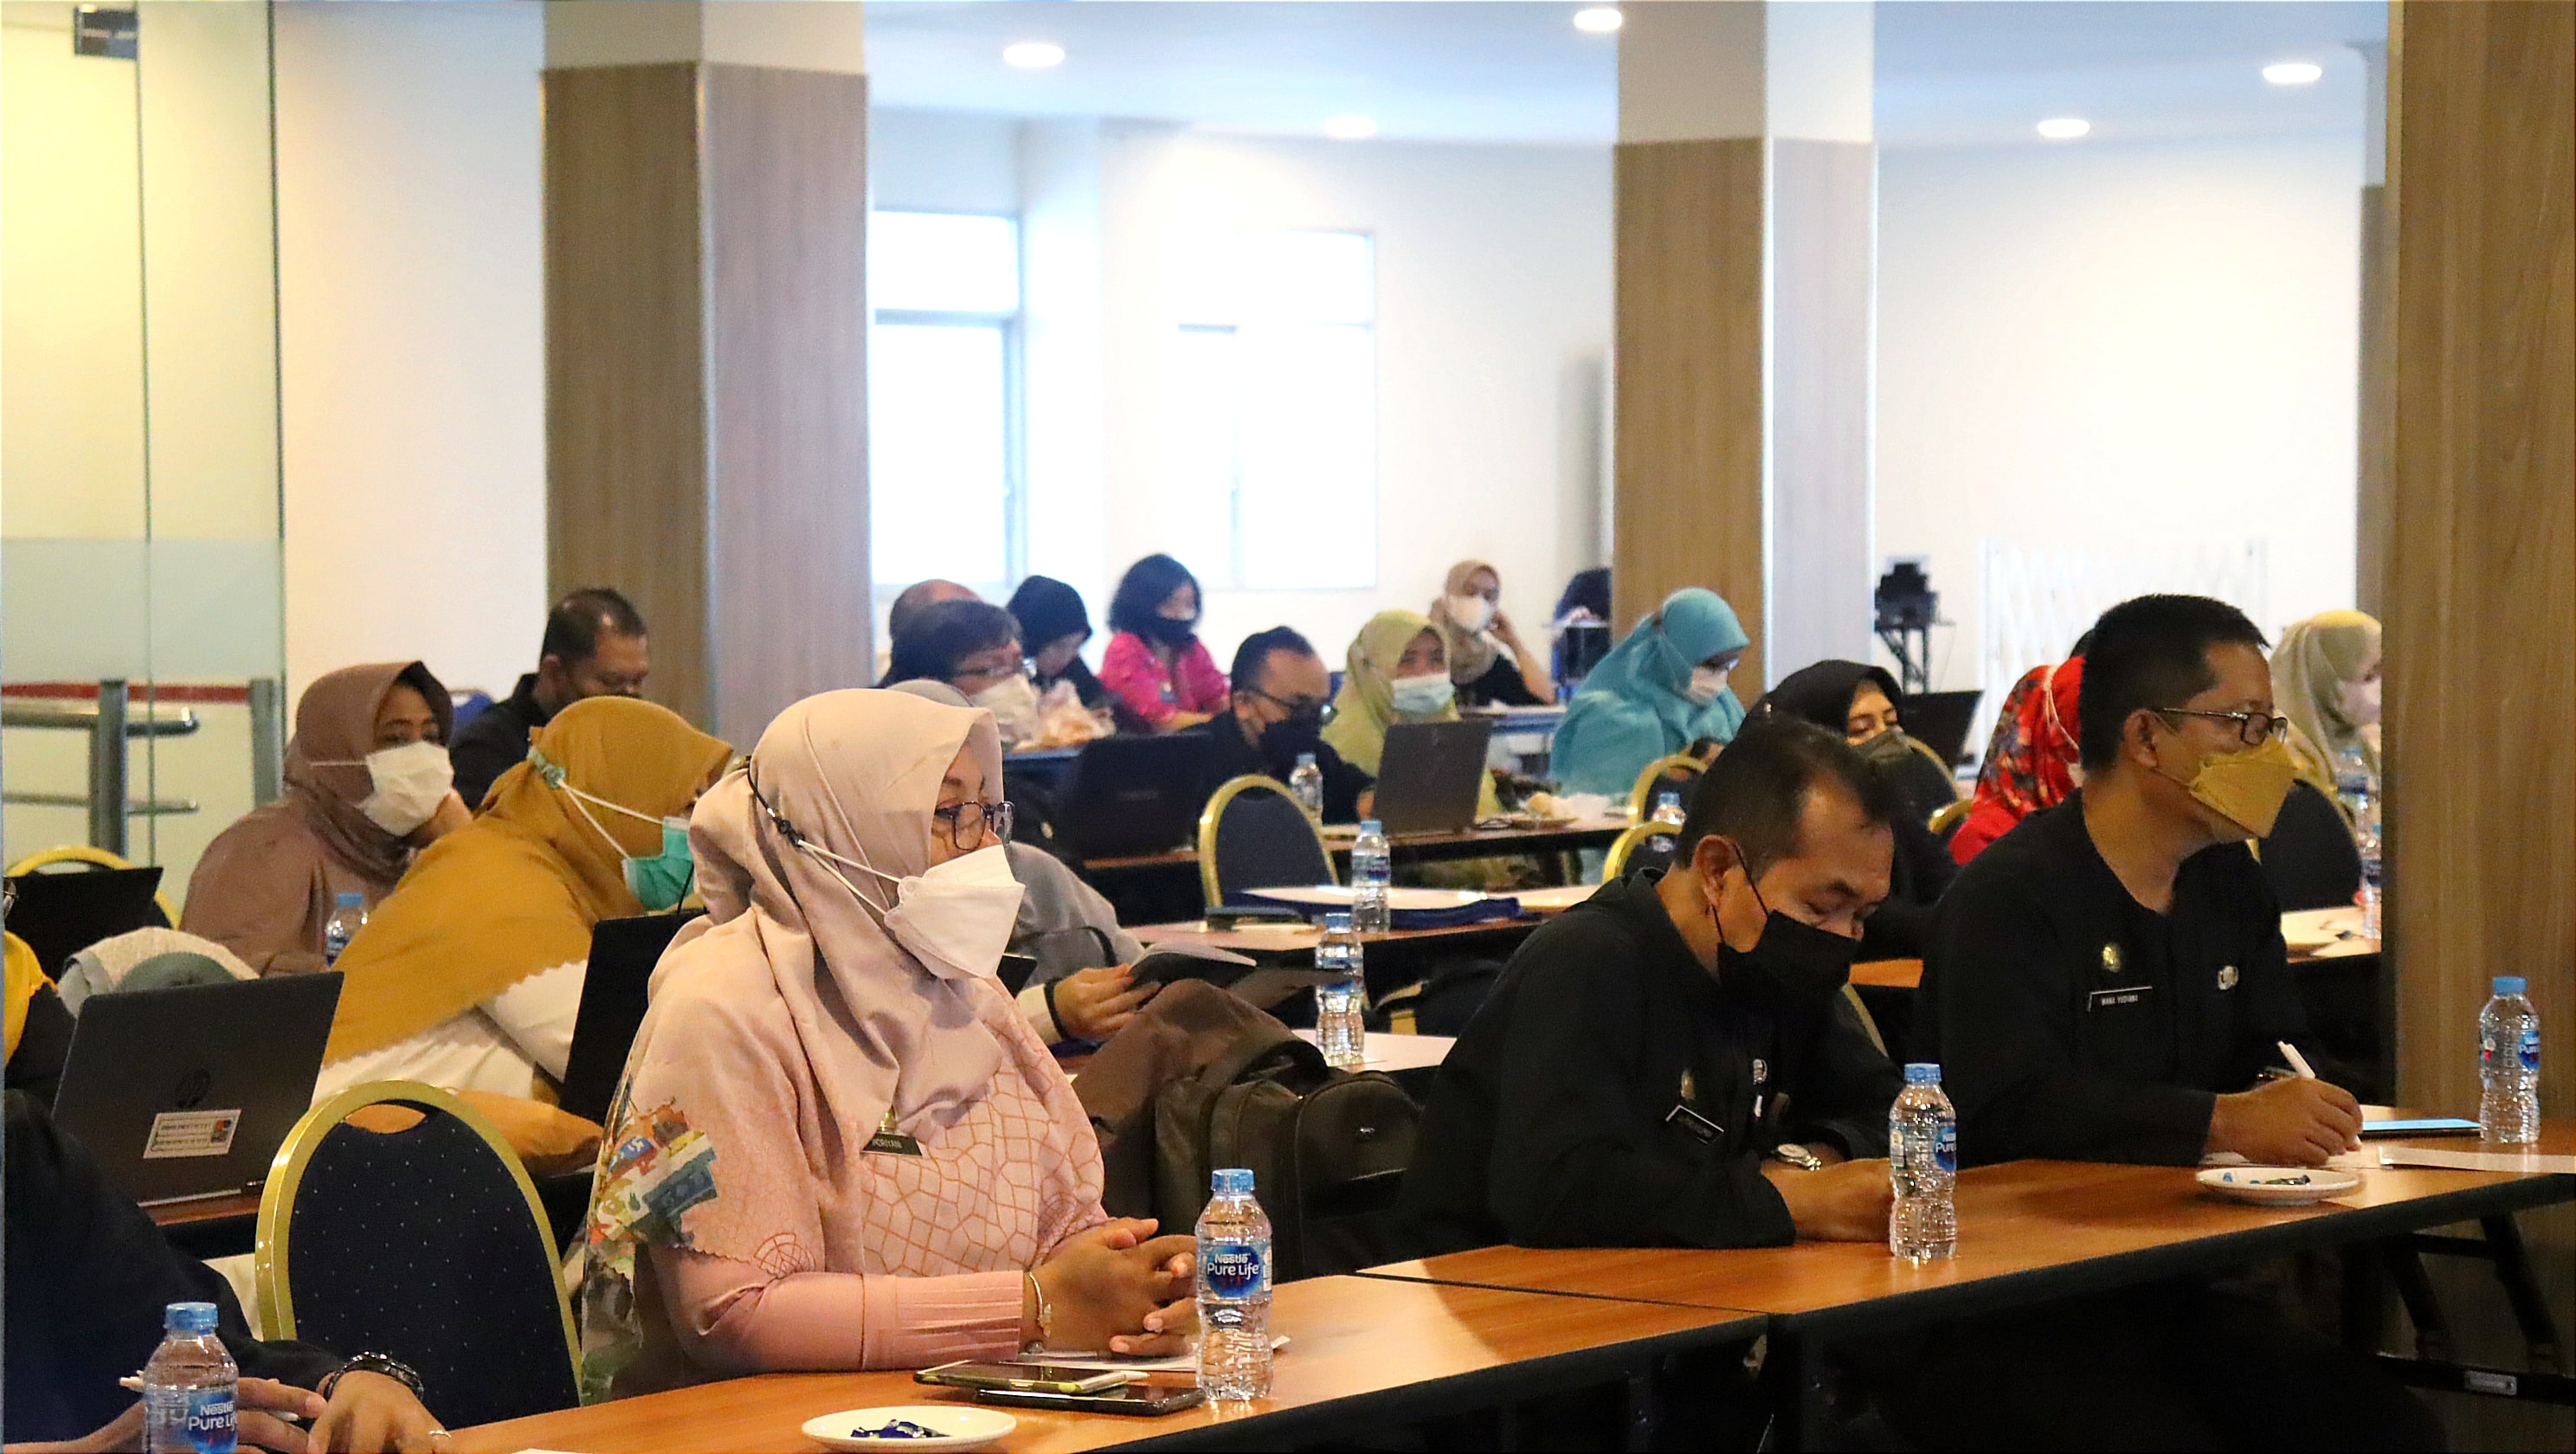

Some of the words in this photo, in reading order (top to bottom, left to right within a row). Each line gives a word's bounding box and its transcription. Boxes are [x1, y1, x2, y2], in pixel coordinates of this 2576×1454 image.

[1207, 1262, 1237, 1276] Pure
[1238, 1263, 1260, 1281] Life
[188, 1415, 225, 1431] Pure
